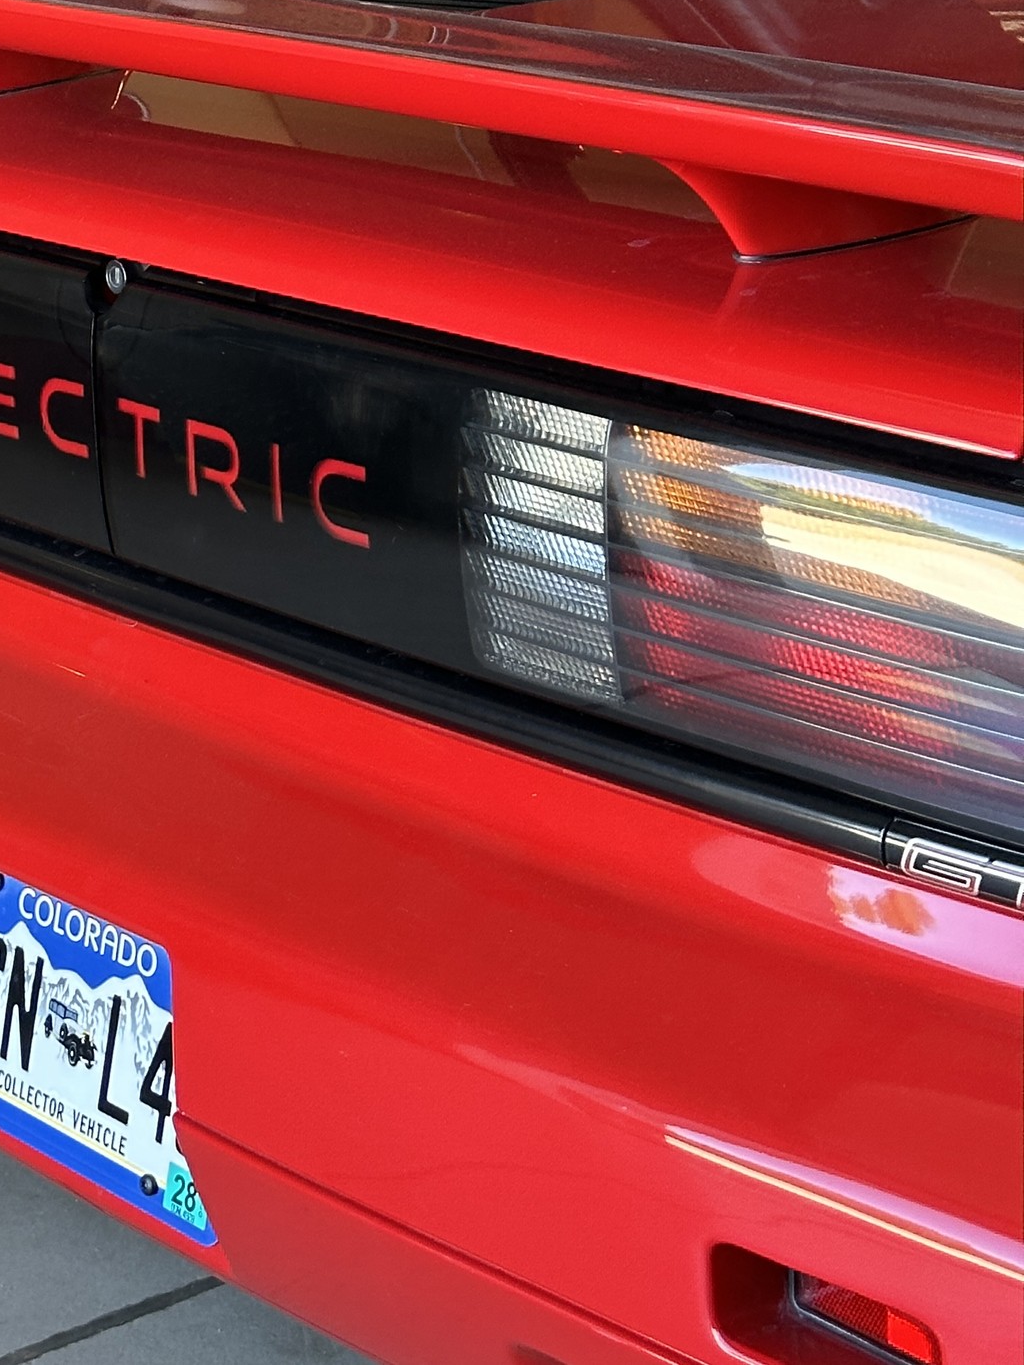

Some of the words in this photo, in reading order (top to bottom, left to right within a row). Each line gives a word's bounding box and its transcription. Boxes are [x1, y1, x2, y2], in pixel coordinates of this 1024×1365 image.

[18, 887, 158, 978] COLORADO
[73, 1108, 127, 1157] VEHICLE
[174, 1173, 197, 1213] 28
